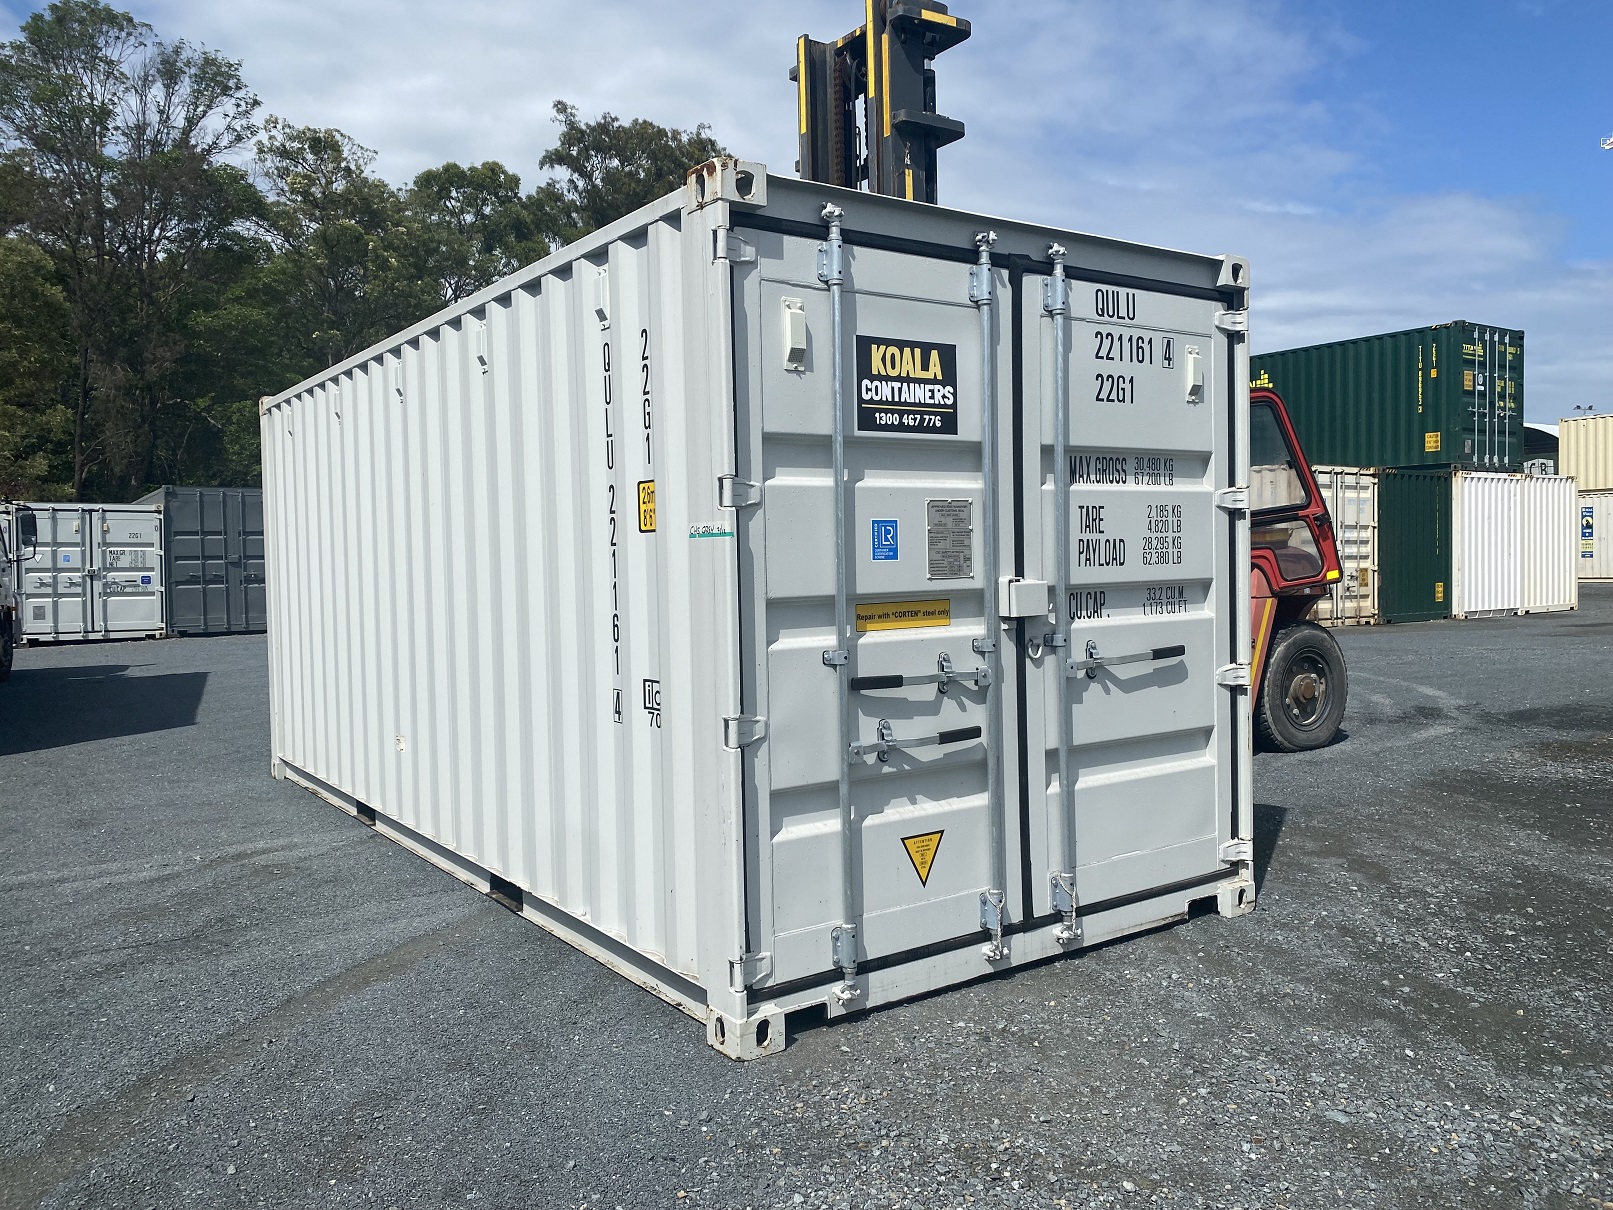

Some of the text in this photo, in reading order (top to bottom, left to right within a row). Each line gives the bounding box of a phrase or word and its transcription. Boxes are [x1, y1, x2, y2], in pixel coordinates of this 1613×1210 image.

[1095, 288, 1136, 321] QULU
[871, 343, 943, 380] KOALA
[1094, 330, 1173, 367] 221161 4
[640, 328, 652, 465] 22G1
[861, 379, 954, 405] CONTAINERS
[1095, 373, 1134, 404] 22G1
[603, 342, 614, 470] QULU
[875, 412, 942, 427] 1300 467 776
[1069, 455, 1174, 485] MAX.GROSS 30.480 KG
[1134, 472, 1174, 486] 67.200 LB
[1078, 504, 1182, 534] TARE 2.185 KG
[1147, 519, 1182, 534] 4.820 LB
[881, 526, 895, 545] LR
[1078, 536, 1182, 568] PAYLOAD 28.295 KG
[1142, 551, 1182, 566] 62.380 LB
[608, 484, 620, 675] 221161
[856, 613, 876, 622] Repair
[877, 611, 890, 620] with
[922, 608, 937, 617] steel
[937, 608, 949, 617] only
[1068, 586, 1187, 621] CU.CAP. 33.2 CU.M.
[1142, 602, 1164, 616] 1.173
